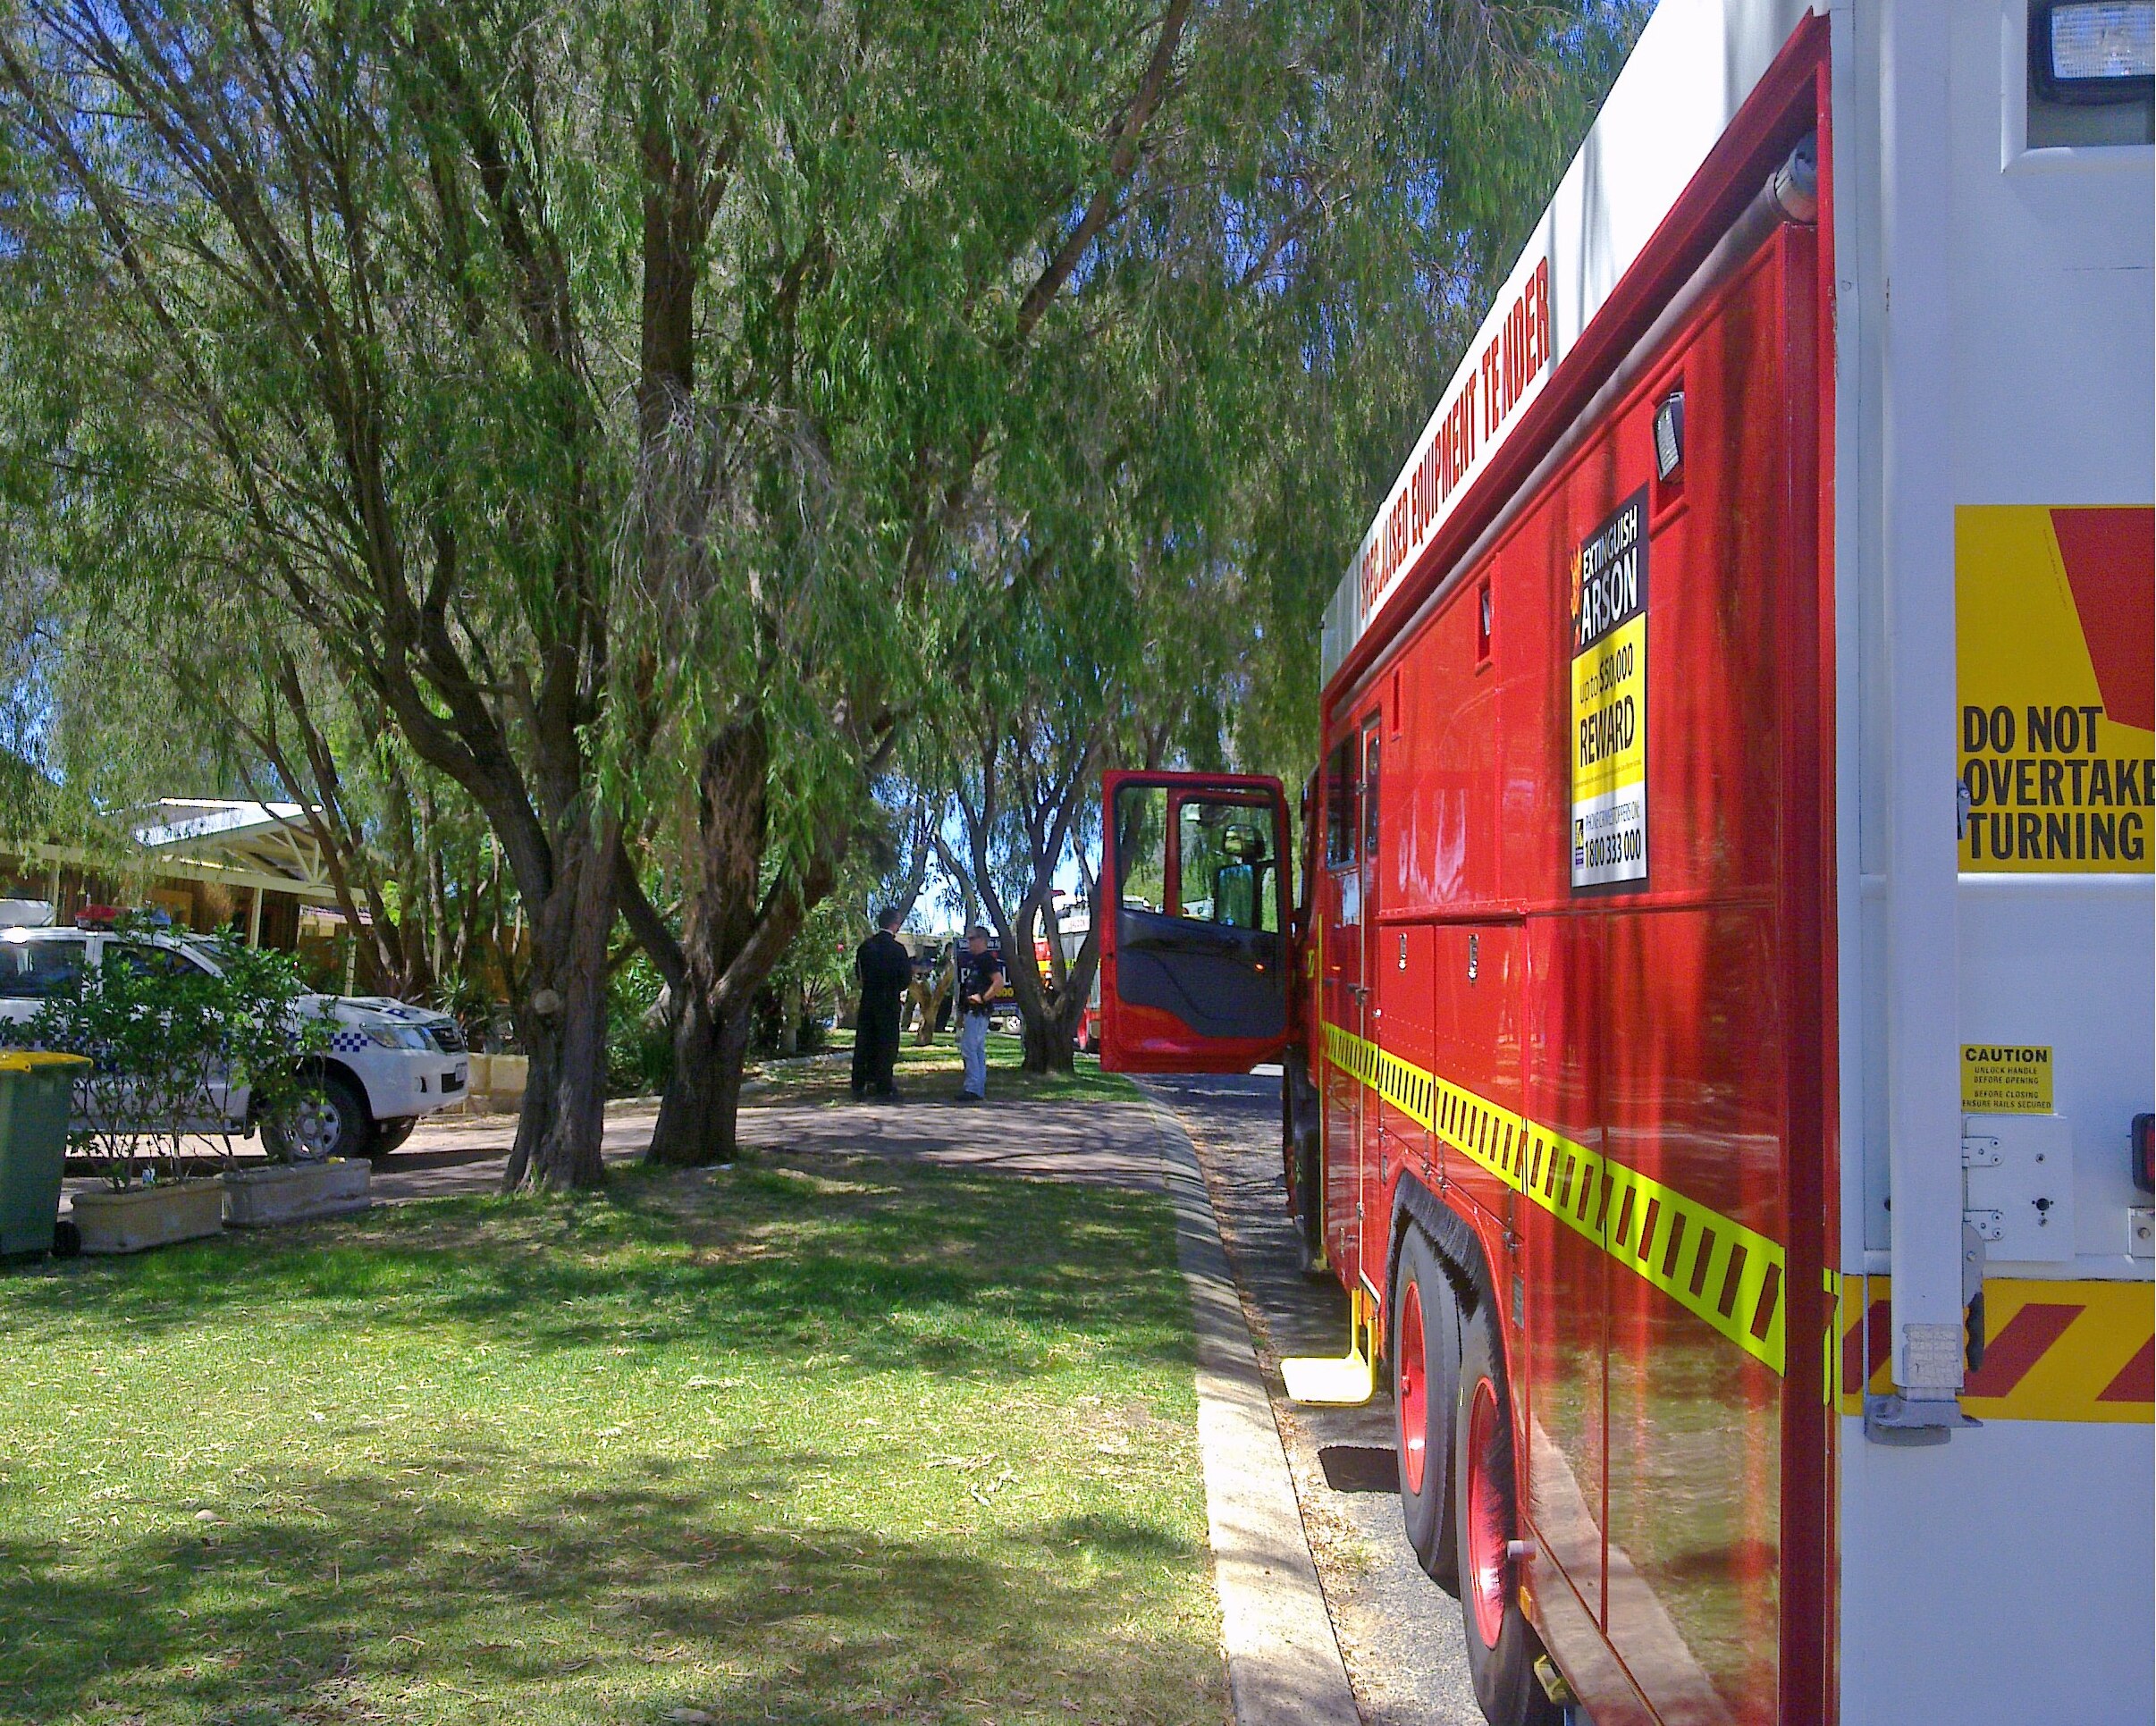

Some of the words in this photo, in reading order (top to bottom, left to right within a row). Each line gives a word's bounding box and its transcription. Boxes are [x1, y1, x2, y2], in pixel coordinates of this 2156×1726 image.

[1360, 487, 1408, 619] SPECALISED
[1412, 368, 1477, 548] EQUIPMENT
[1482, 256, 1550, 443] TENDER
[1583, 504, 1638, 583] EXTINGUISH
[1580, 546, 1638, 645] ARSON
[1580, 681, 1590, 709] up
[1590, 675, 1598, 698] to
[1580, 695, 1635, 767] REWARD
[1963, 705, 2015, 754] DO
[2027, 705, 2103, 754] NOT
[1963, 758, 2155, 806] OVERTAKE
[1586, 837, 1604, 869] 1800
[1606, 832, 1622, 865] 333
[1624, 828, 1641, 862] 000
[1967, 812, 2144, 861] TURNING
[1966, 1048, 2048, 1063] CAUTION
[1962, 1099, 1991, 1108] ENSURE
[2017, 1101, 2051, 1109] SECURED
[1974, 1076, 2003, 1084] BEFORE
[2005, 1077, 2039, 1085] OPENING
[1974, 1090, 2003, 1099] BEFORE
[2006, 1090, 2039, 1099] CLOSING
